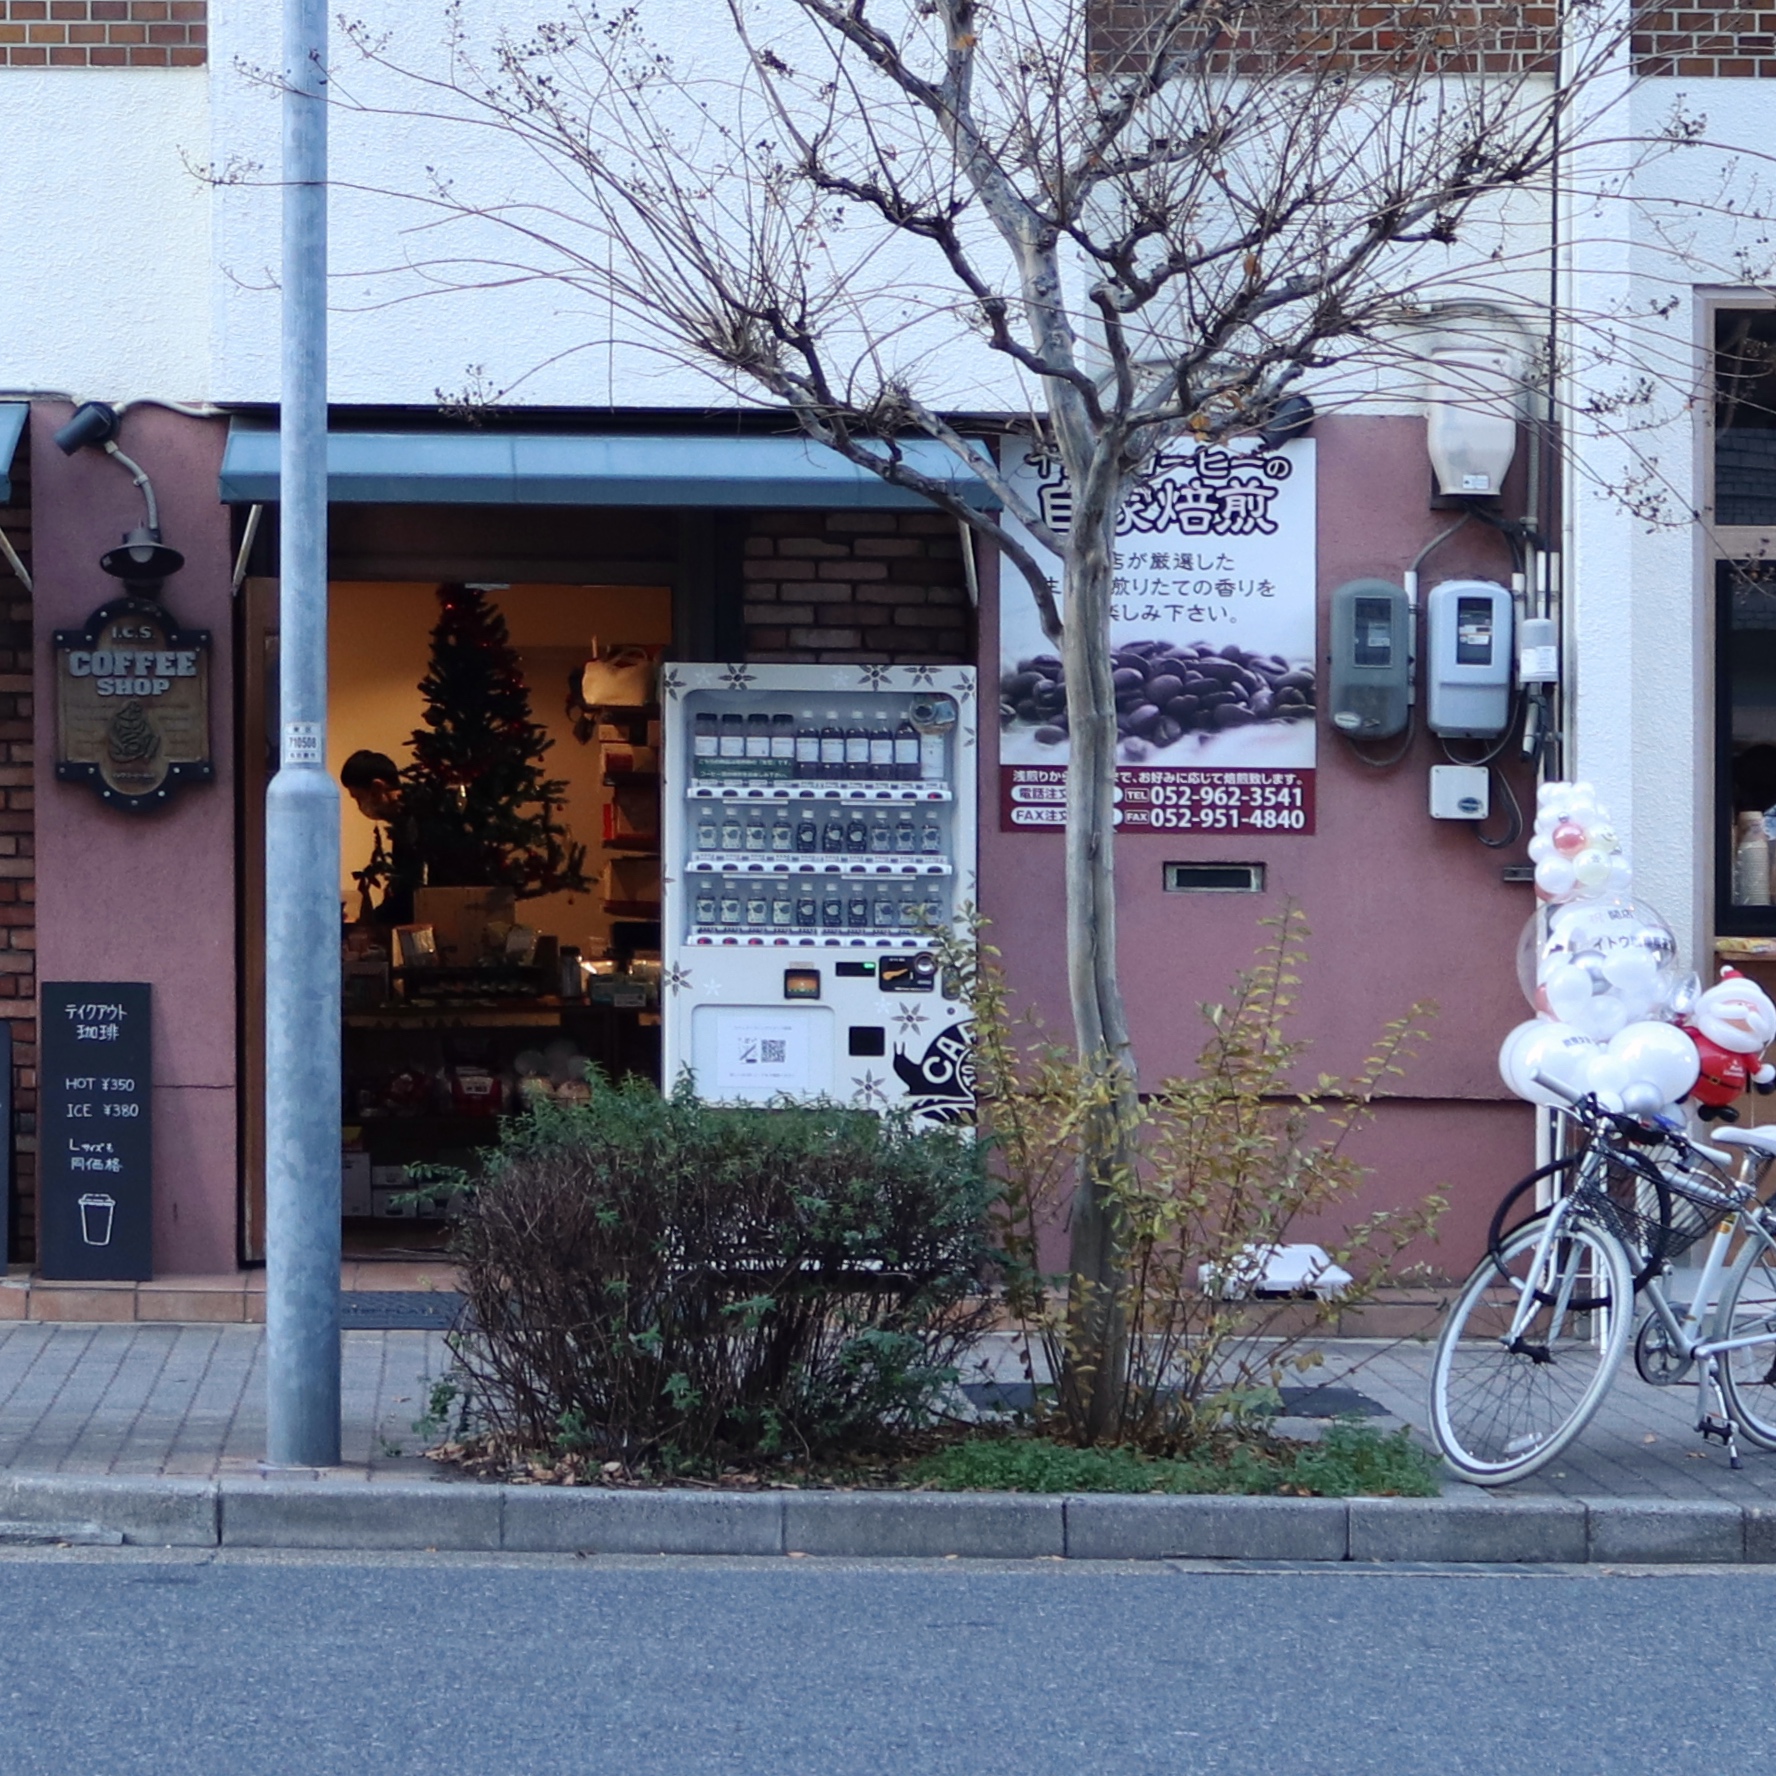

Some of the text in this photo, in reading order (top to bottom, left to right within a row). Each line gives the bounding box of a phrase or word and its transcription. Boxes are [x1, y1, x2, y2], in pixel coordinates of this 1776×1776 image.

[69, 650, 197, 677] COFFEE
[96, 677, 170, 696] SHOP
[1127, 790, 1148, 801] TEL
[1150, 786, 1303, 807] 052-962-3541
[1127, 812, 1148, 822] FAX
[1150, 808, 1305, 829] 052-951-4840
[65, 1004, 128, 1020] テイクアウト
[76, 1024, 120, 1041] 珈琲
[65, 1078, 135, 1092] HOT ¥350
[67, 1104, 139, 1117] ICE ¥380
